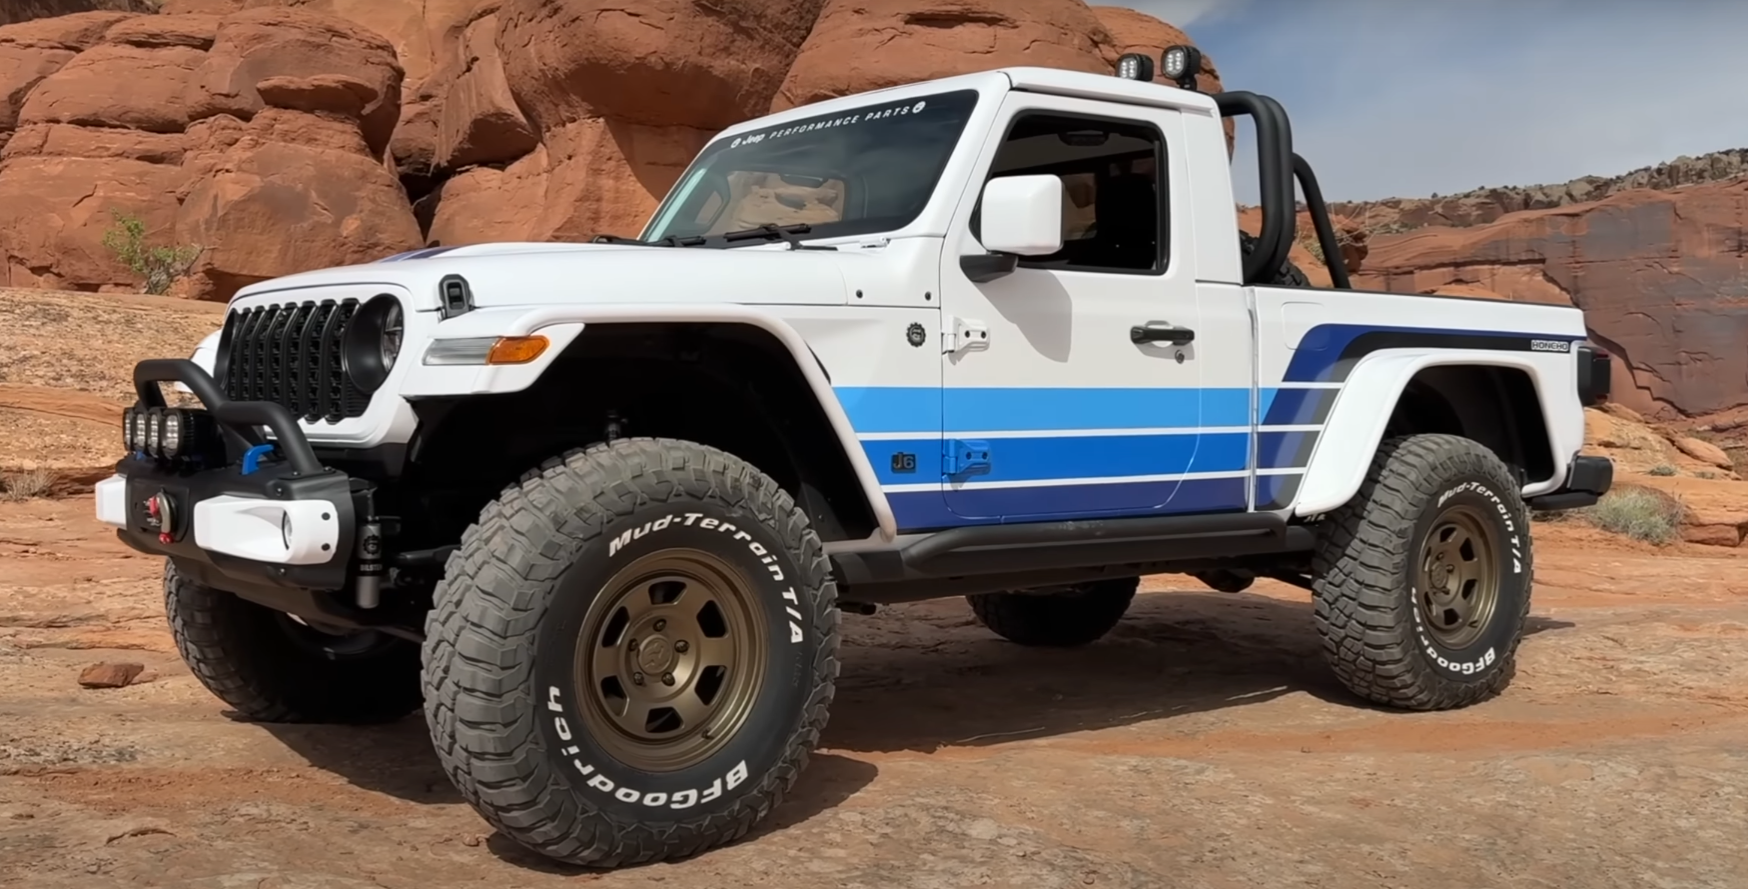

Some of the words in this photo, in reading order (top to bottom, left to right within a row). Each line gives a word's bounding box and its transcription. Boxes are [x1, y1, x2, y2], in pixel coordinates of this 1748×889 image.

[742, 134, 765, 145] Jeep
[769, 115, 859, 139] PERFORMANCE
[865, 106, 910, 121] PARTS
[1532, 341, 1568, 350] HONCHO
[893, 452, 914, 469] J6
[1437, 482, 1514, 531] Mud-Terrain
[1511, 535, 1522, 573] T/A
[609, 513, 784, 581] Mud-Terrain
[782, 587, 803, 643] T/A
[1411, 587, 1495, 674] BFGoodrich
[548, 686, 749, 809] BFGoodrich
